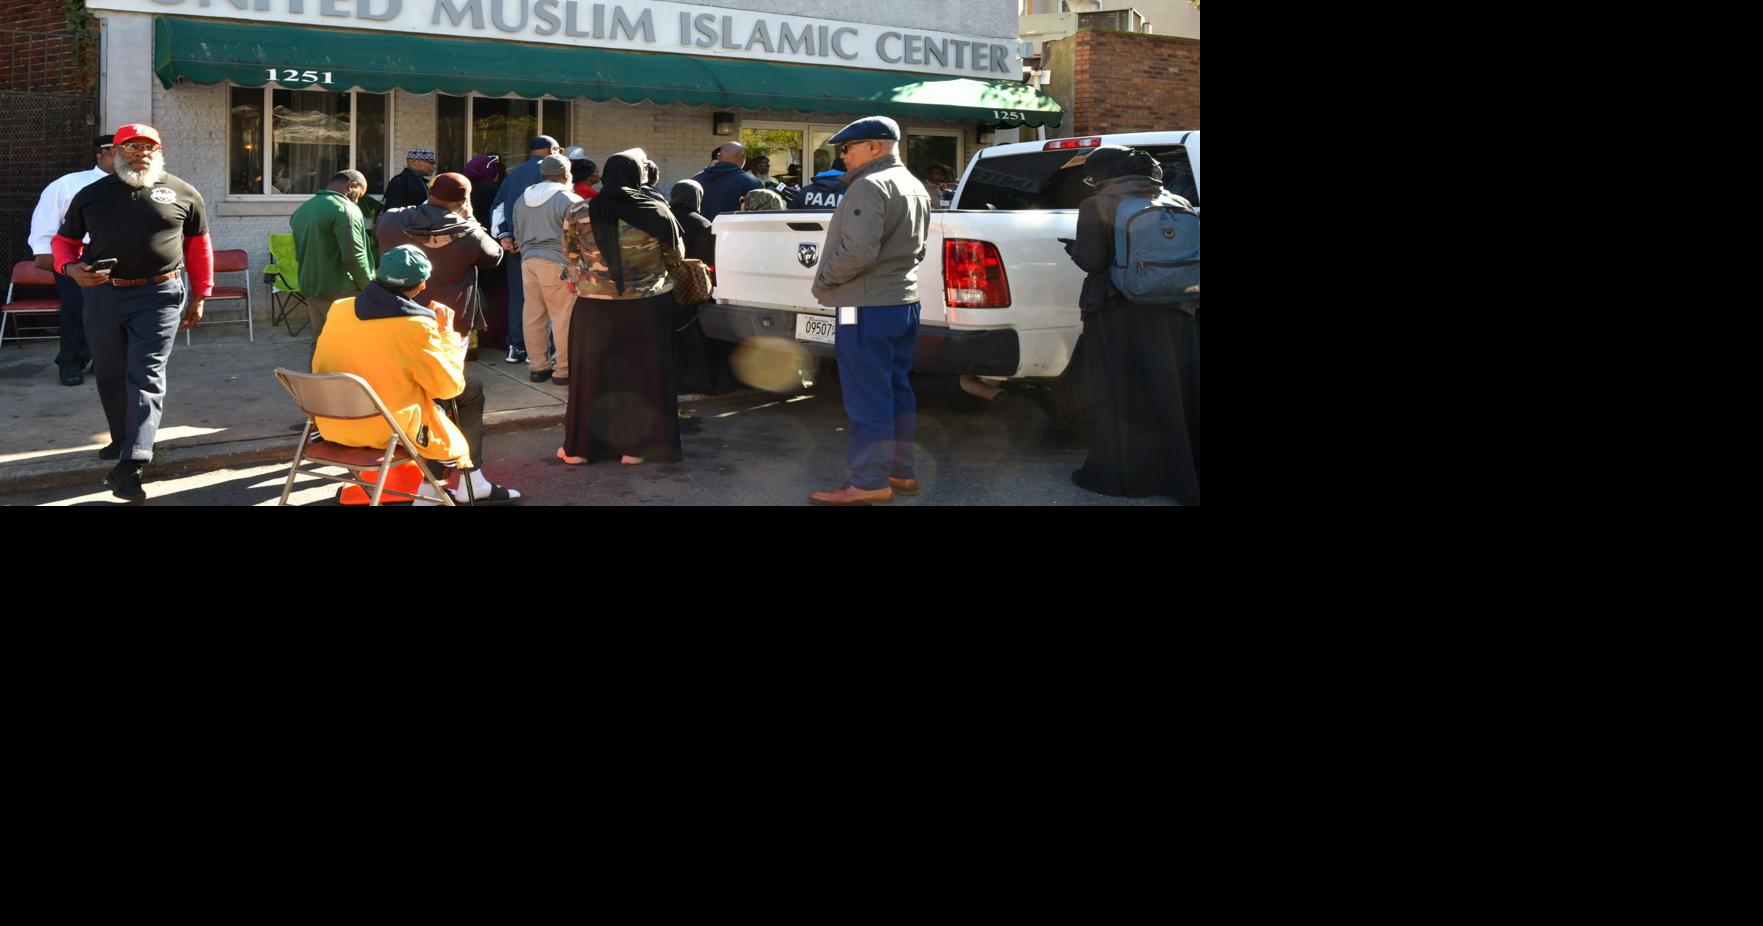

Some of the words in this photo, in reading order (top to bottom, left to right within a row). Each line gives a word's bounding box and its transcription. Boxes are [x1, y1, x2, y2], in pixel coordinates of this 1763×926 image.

[432, 0, 656, 43] MUSLIM
[680, 12, 858, 60] ISLAMIC
[876, 31, 1010, 73] CENTER
[265, 68, 335, 84] 1251
[993, 110, 1026, 121] 1251
[805, 320, 832, 336] 09507
